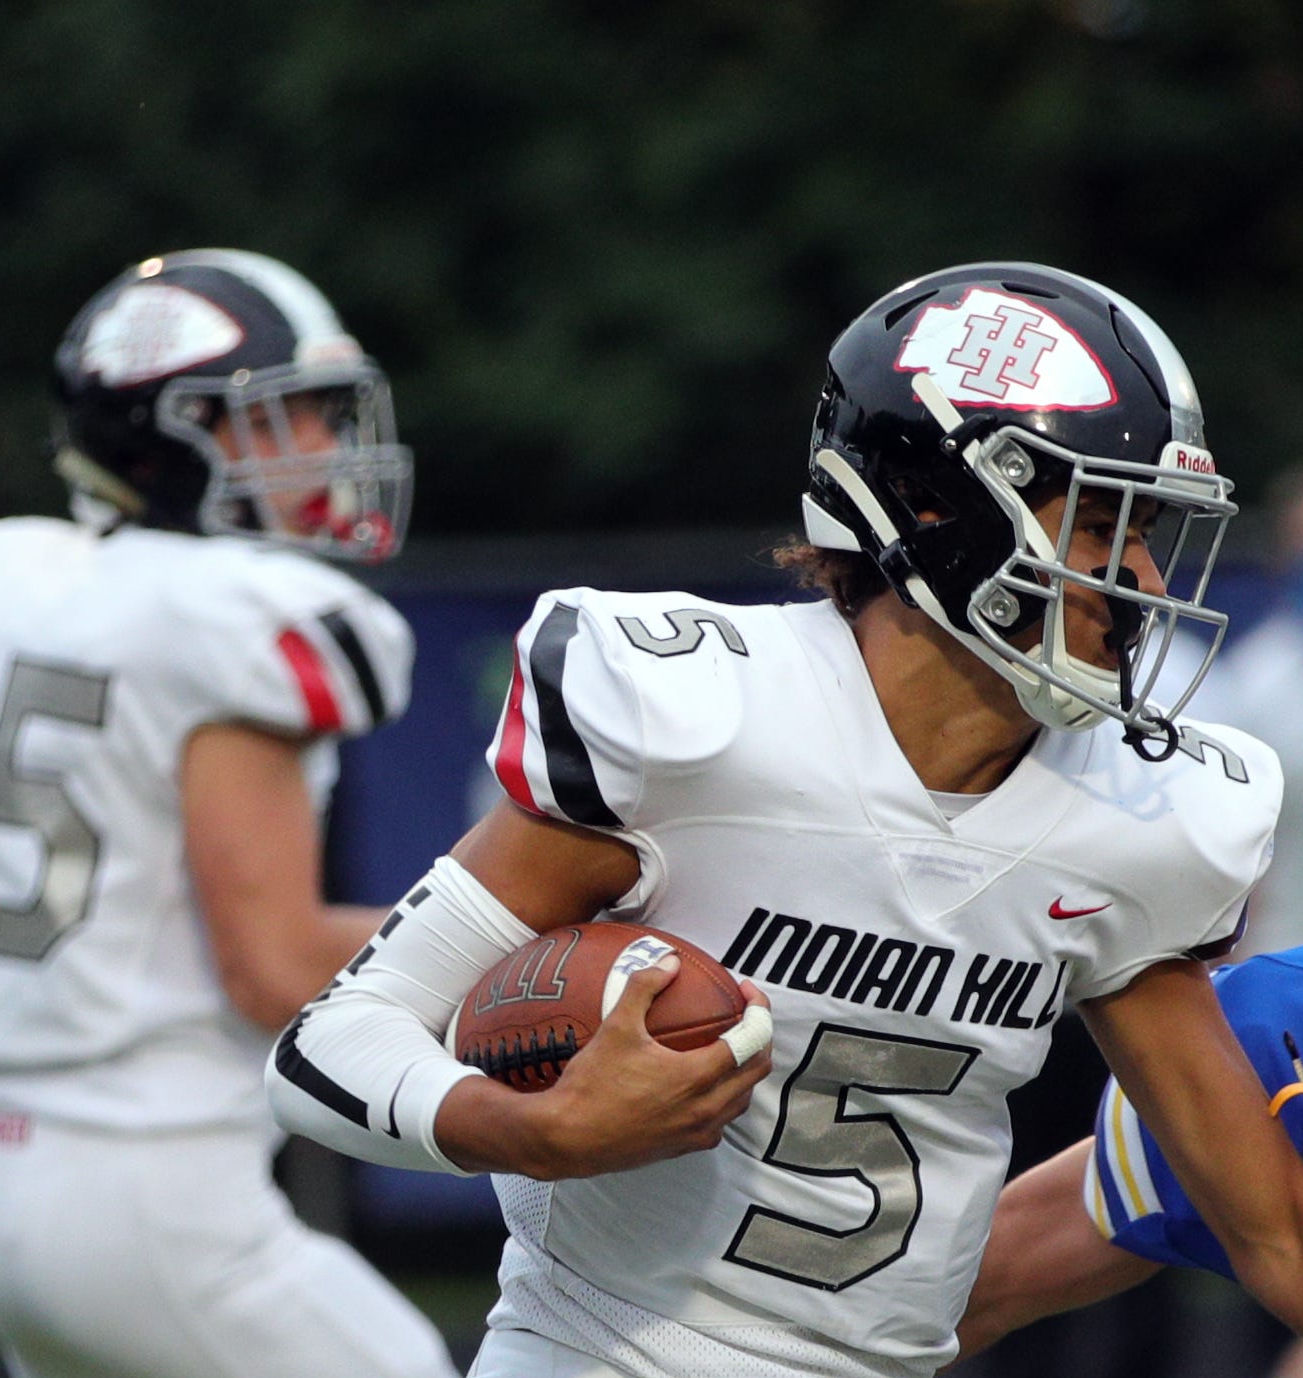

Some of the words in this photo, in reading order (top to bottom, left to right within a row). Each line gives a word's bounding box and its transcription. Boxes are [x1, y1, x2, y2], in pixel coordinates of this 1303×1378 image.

[614, 608, 750, 658] 5
[721, 907, 955, 1016] INDIAN
[722, 1021, 983, 1293] 5
